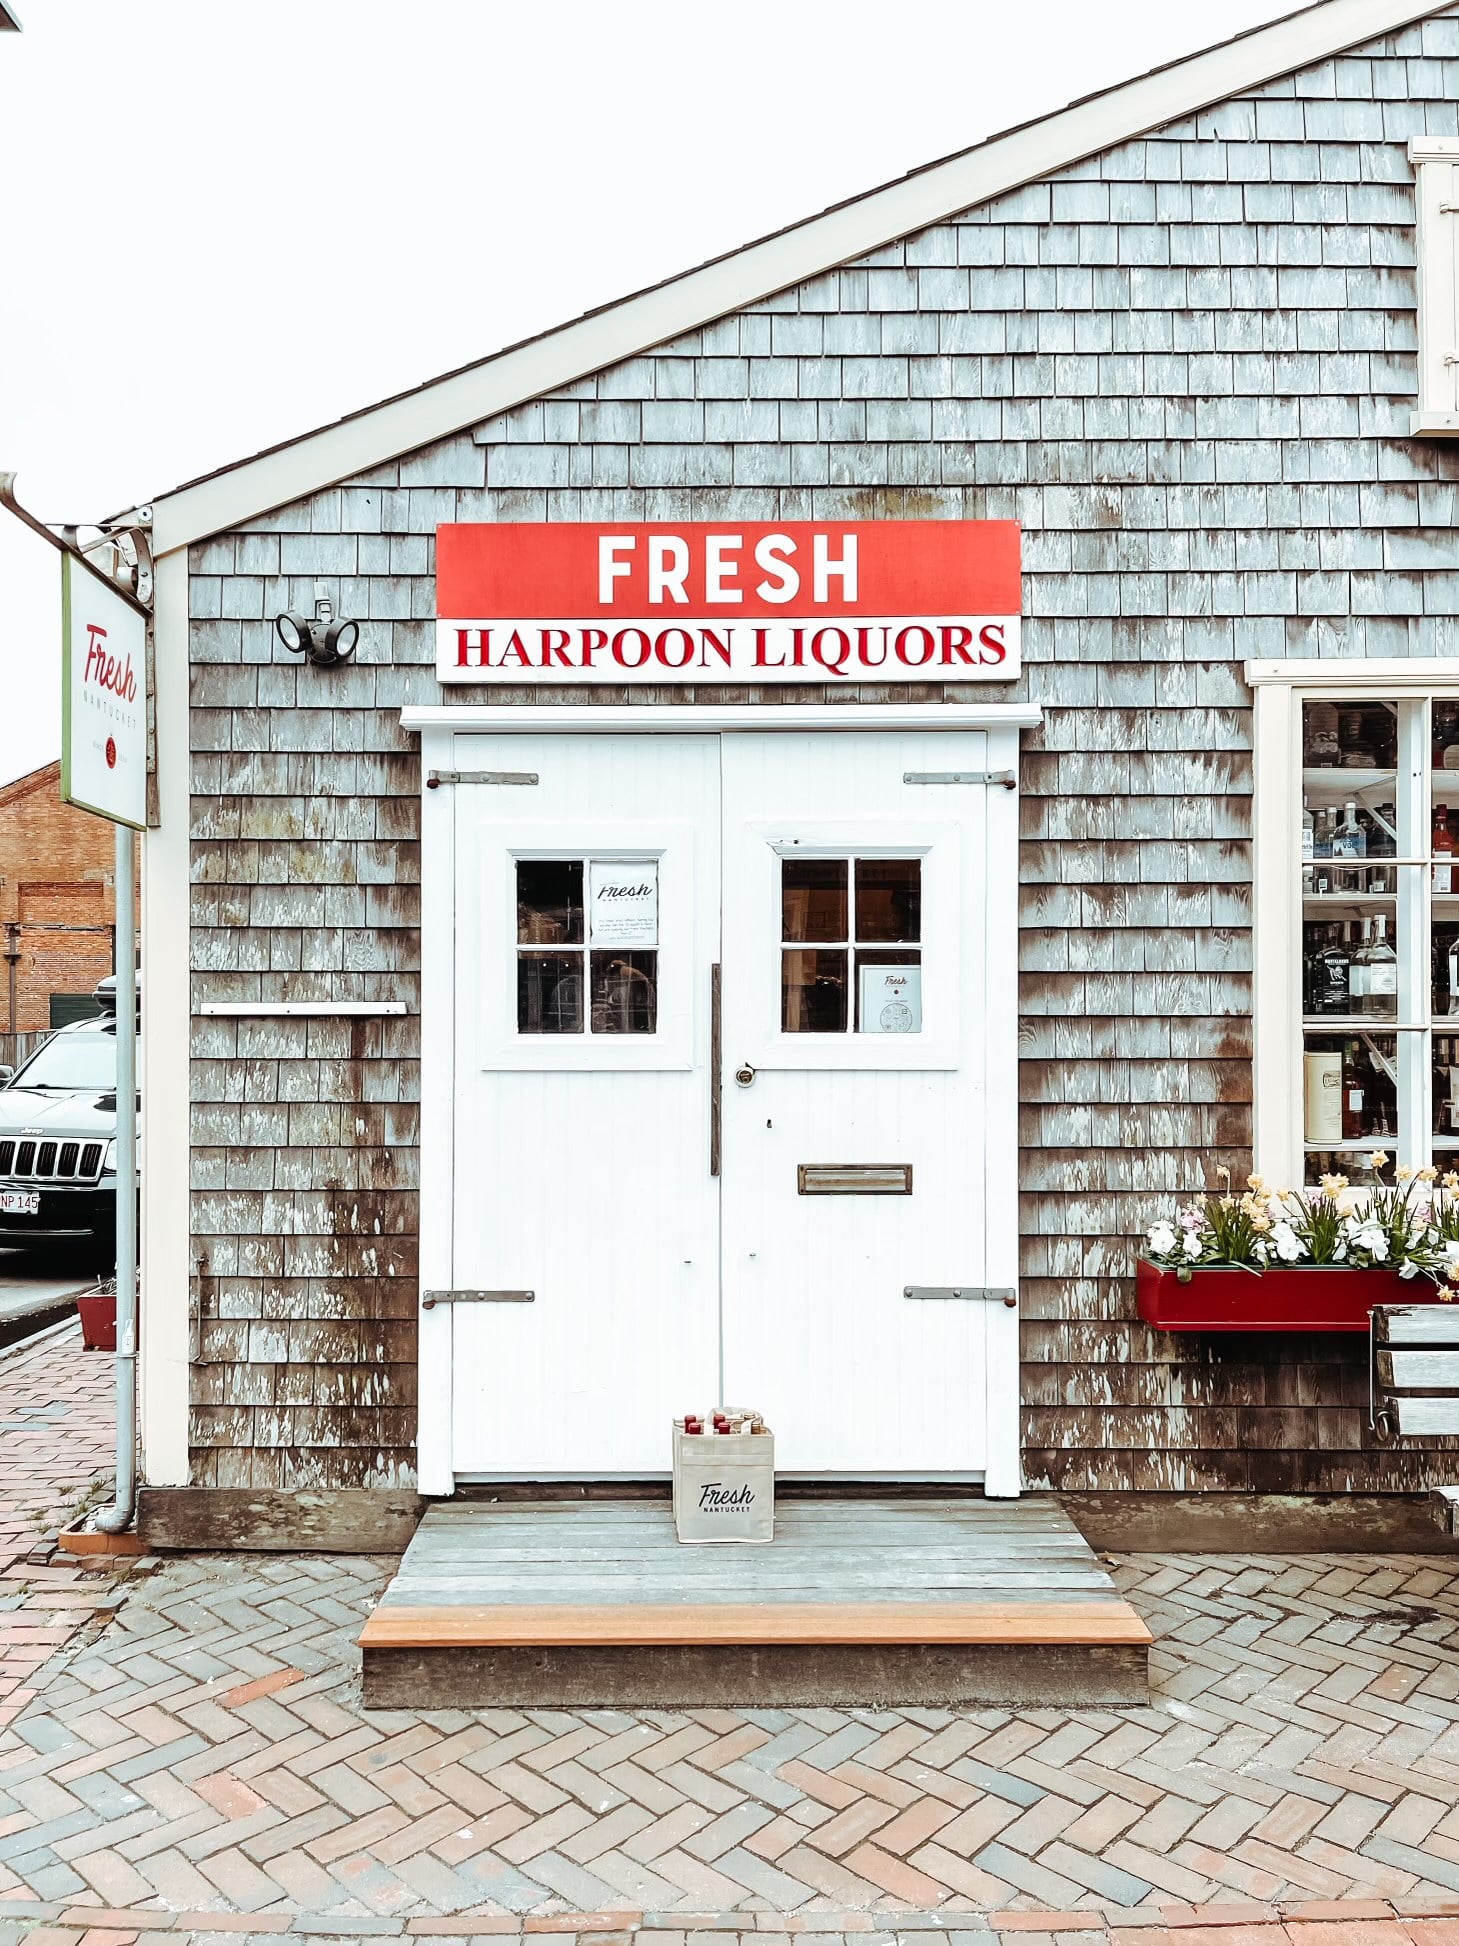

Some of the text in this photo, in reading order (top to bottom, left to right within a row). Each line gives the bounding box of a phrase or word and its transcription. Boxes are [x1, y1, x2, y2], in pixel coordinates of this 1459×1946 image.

[598, 534, 859, 604] FRESH
[454, 624, 1007, 676] HARPOON LIQUORS
[84, 624, 137, 703] Fresh
[597, 881, 653, 900] Fresh
[884, 975, 908, 985] Fresh
[18, 1195, 37, 1208] 145
[699, 1483, 755, 1507] Fresh
